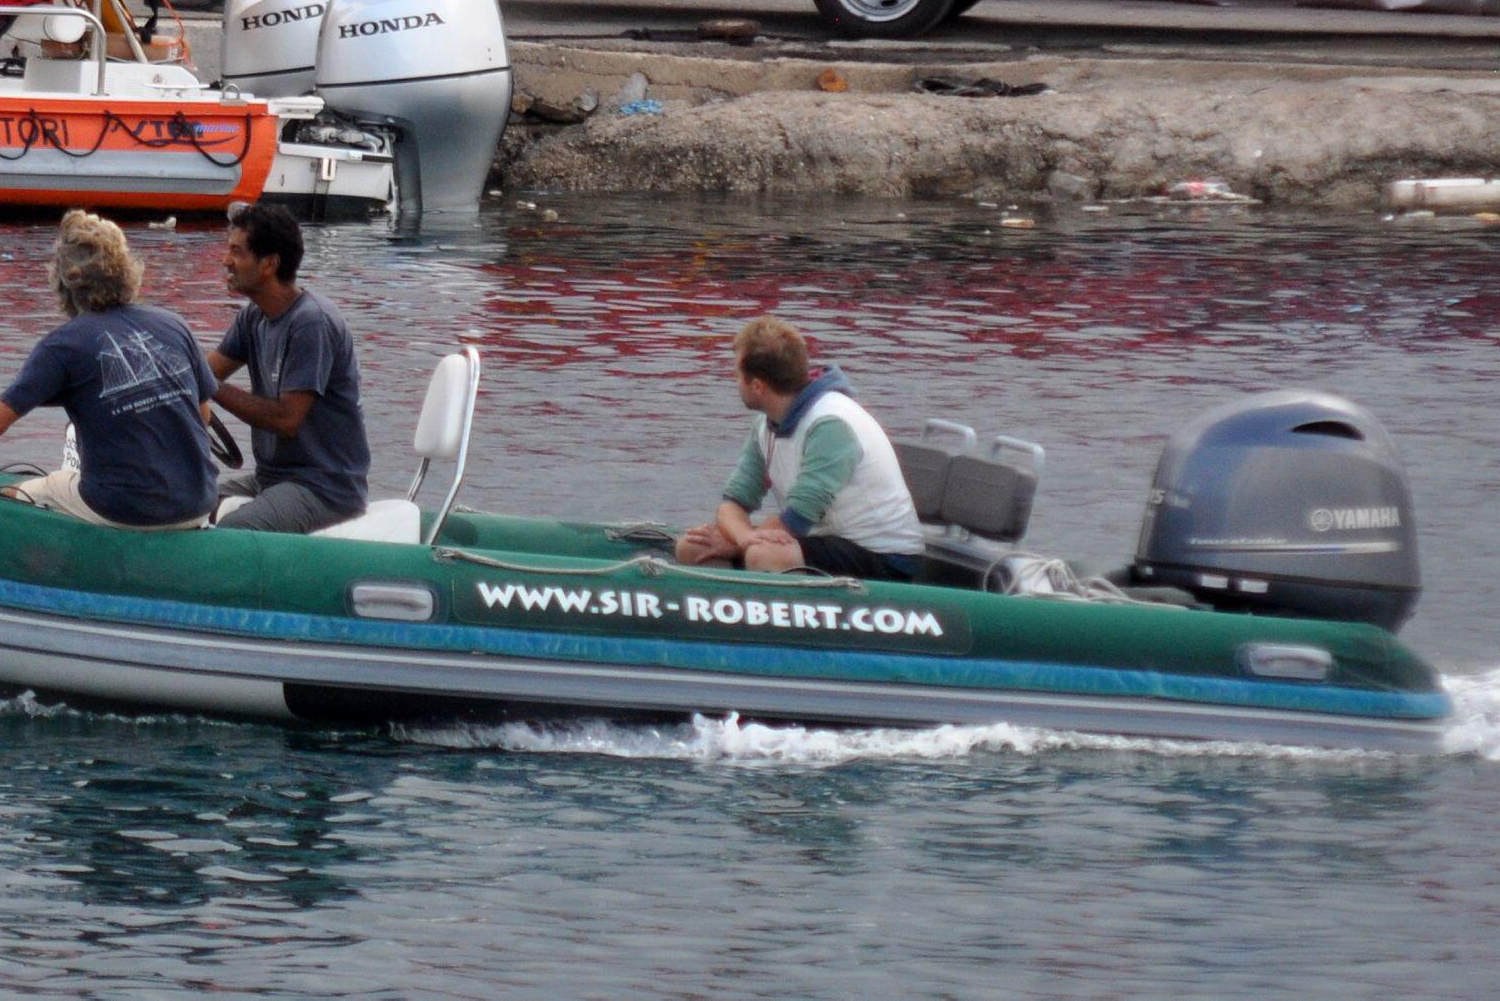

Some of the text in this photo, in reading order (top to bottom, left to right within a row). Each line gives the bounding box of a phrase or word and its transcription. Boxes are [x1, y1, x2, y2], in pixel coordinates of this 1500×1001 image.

[241, 2, 329, 31] HOND
[338, 12, 445, 39] HONDA
[1334, 506, 1400, 530] YAMAHA
[477, 582, 943, 636] WWW.SIR-ROBERT.COM
